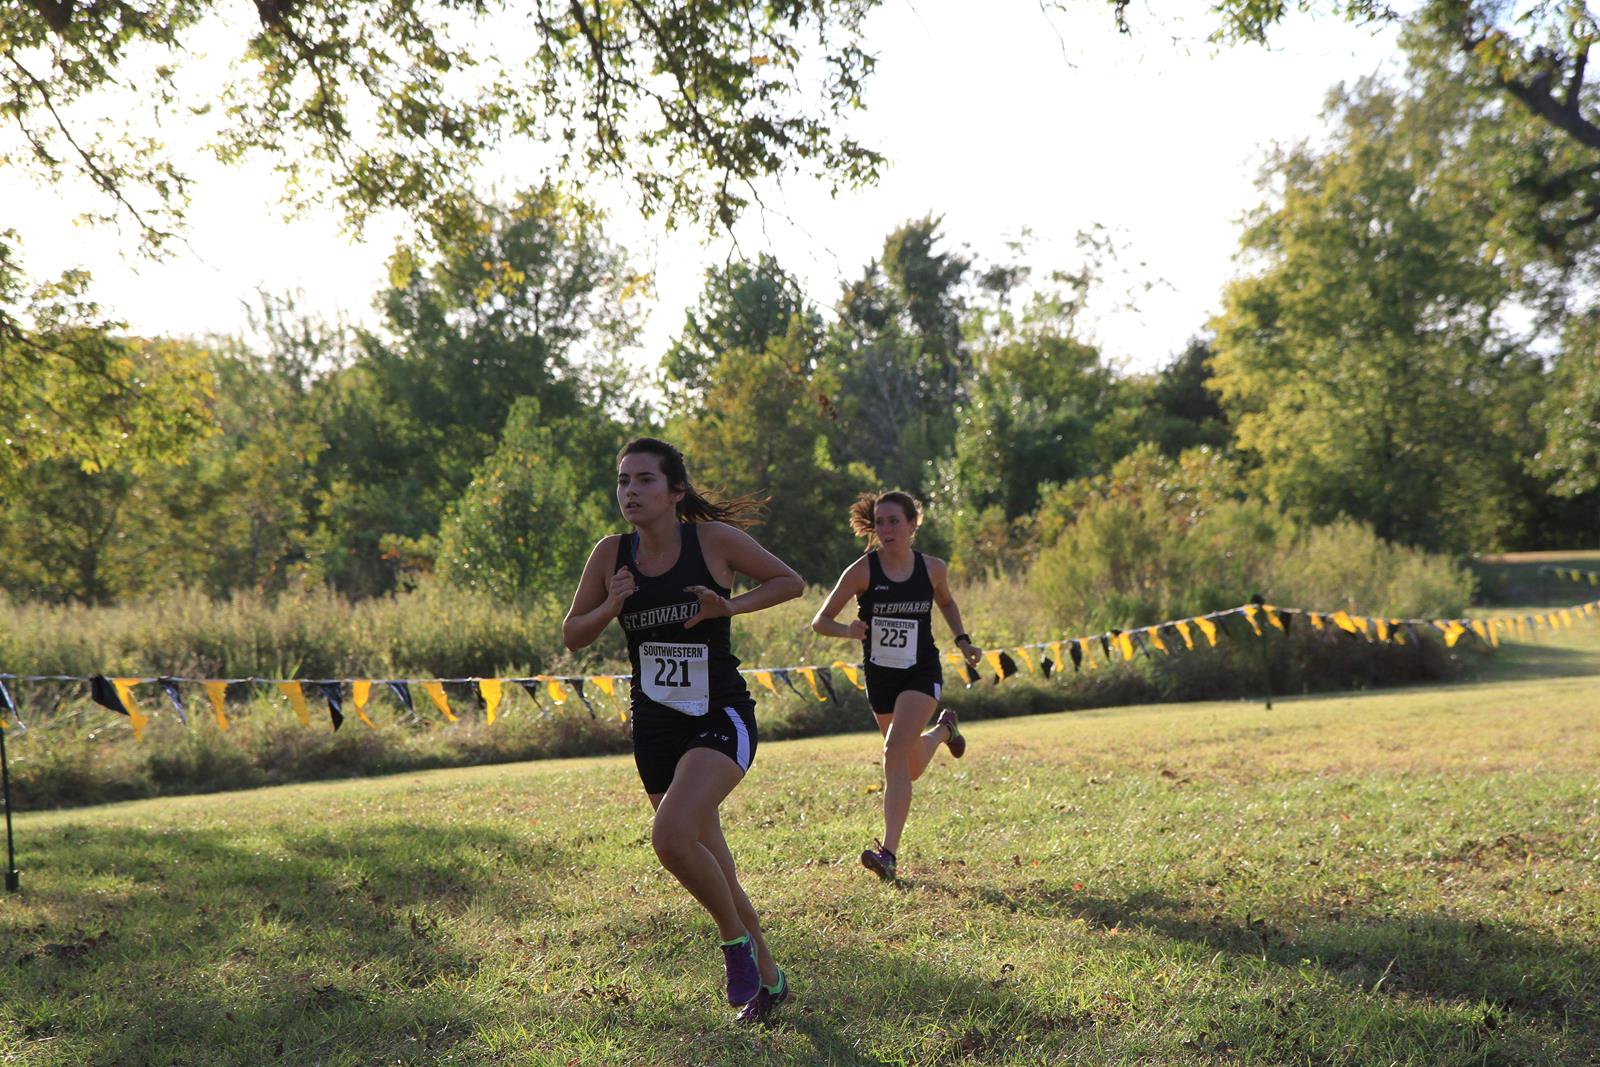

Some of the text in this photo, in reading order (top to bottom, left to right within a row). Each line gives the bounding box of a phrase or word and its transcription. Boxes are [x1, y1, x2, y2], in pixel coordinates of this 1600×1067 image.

[873, 618, 915, 629] SOUTHWESTERN
[880, 628, 908, 648] 225
[643, 645, 703, 658] SOUTHWESTERN
[654, 658, 692, 687] 221
